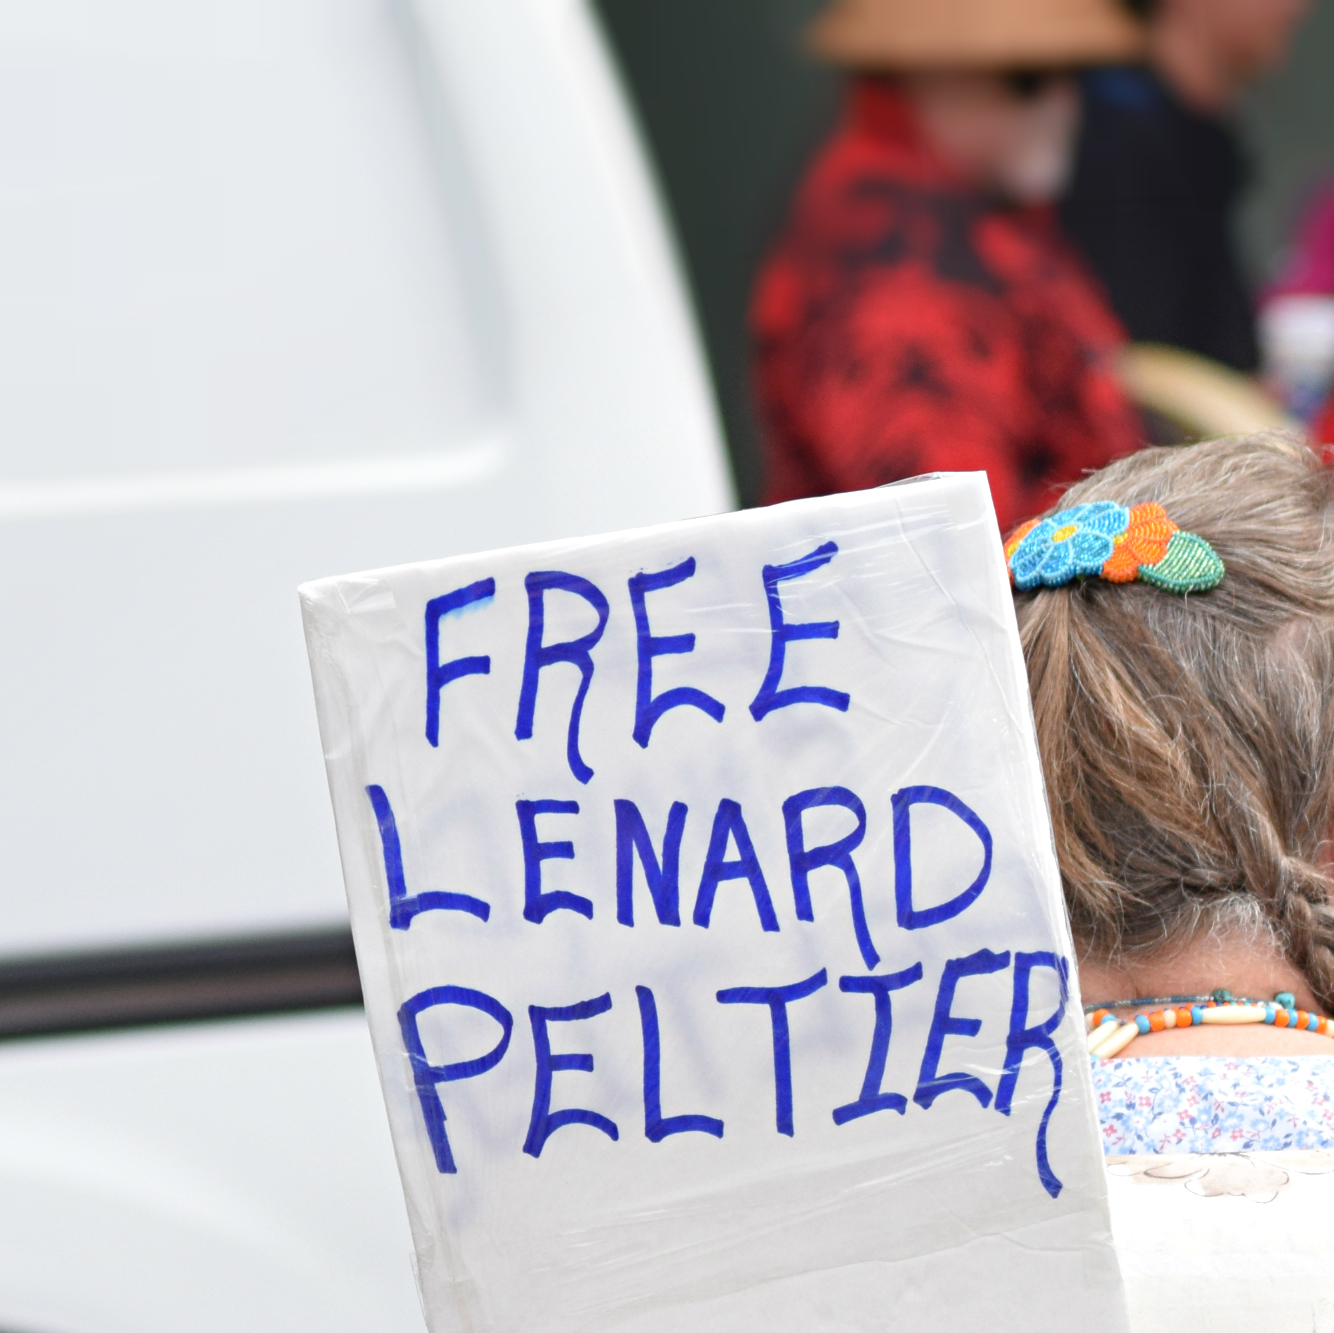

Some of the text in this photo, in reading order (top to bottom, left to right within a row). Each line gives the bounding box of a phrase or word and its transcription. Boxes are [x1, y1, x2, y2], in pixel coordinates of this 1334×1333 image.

[424, 541, 852, 785] FREE
[364, 784, 994, 971] LENARD
[397, 947, 1071, 1200] PELTIER
